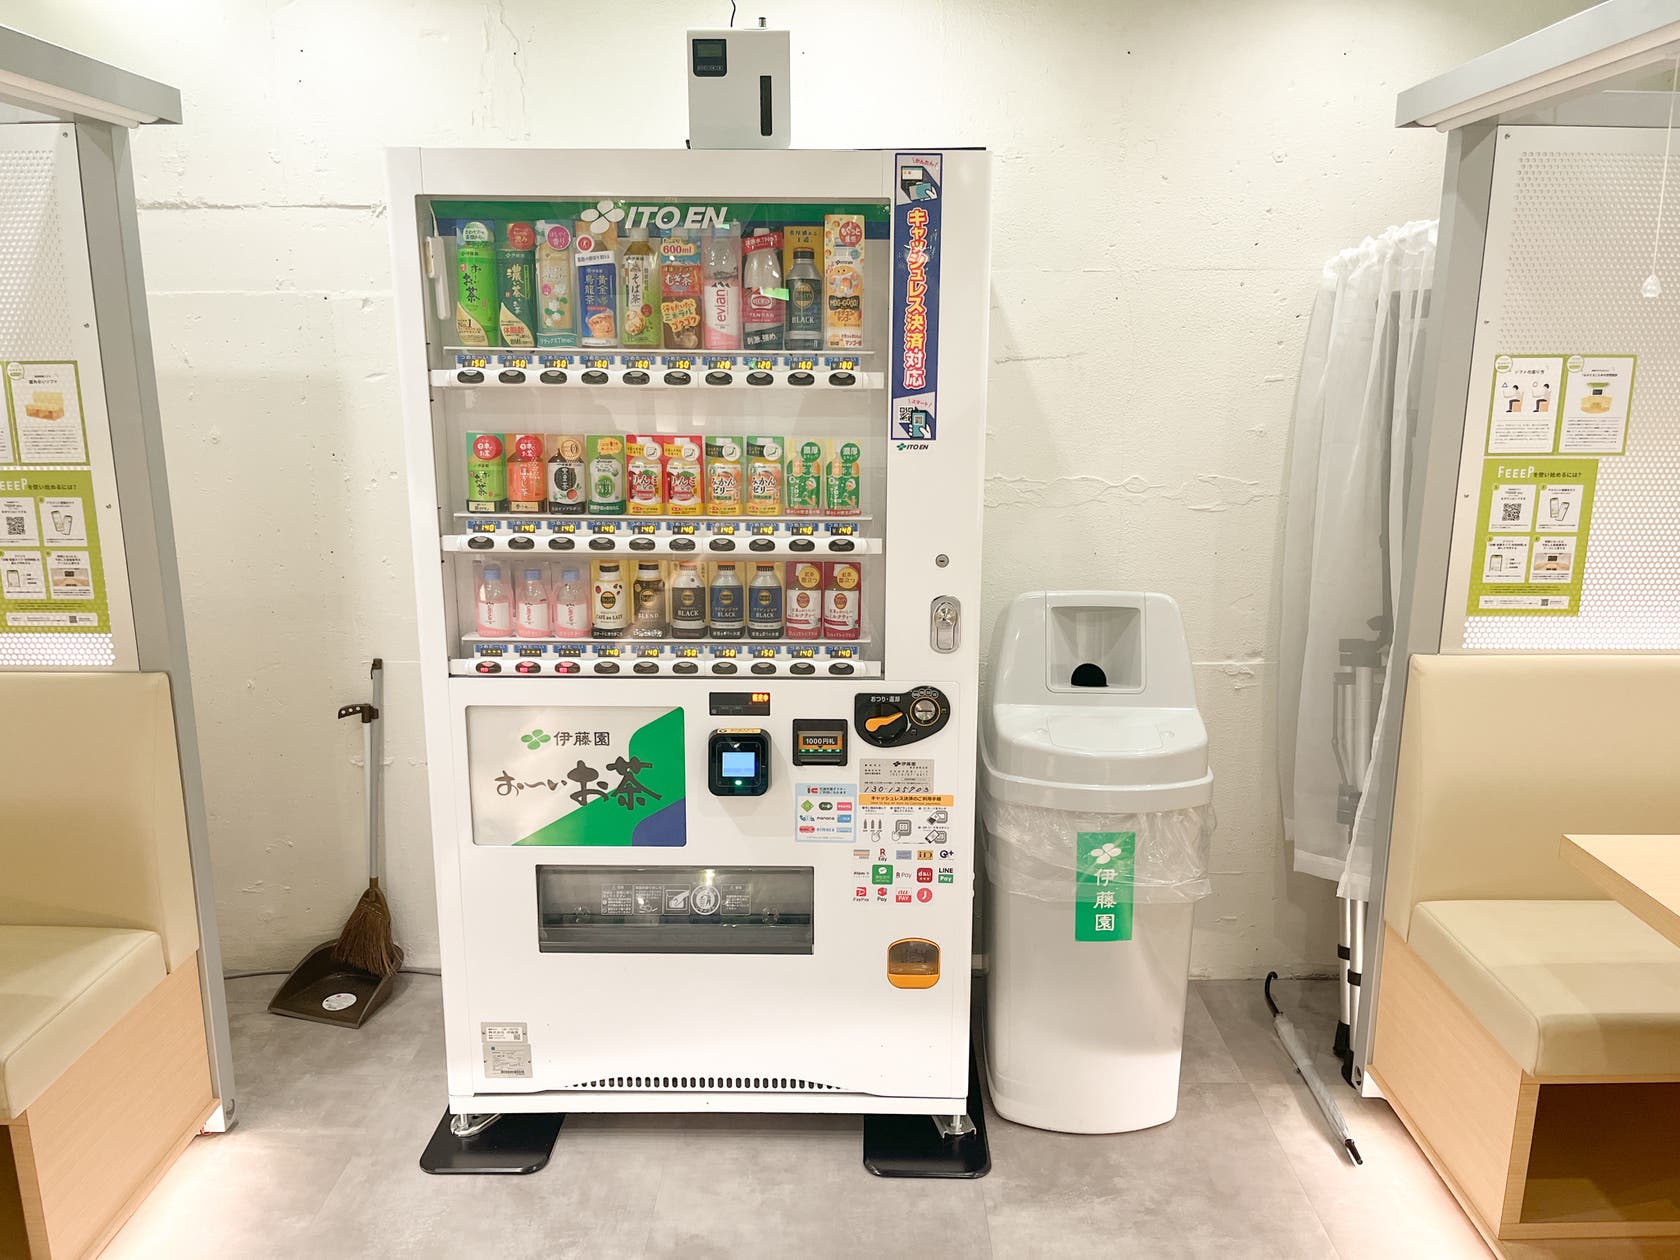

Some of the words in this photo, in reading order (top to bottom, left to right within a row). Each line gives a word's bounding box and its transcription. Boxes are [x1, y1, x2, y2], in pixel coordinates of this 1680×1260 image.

[624, 206, 681, 230] ITO
[682, 206, 728, 230] EN
[663, 245, 692, 254] 600ml
[716, 289, 726, 322] evian
[905, 208, 928, 390] キャッシュレス決済対応
[554, 731, 610, 746] 伊藤園
[1092, 868, 1118, 931] 伊藤園
